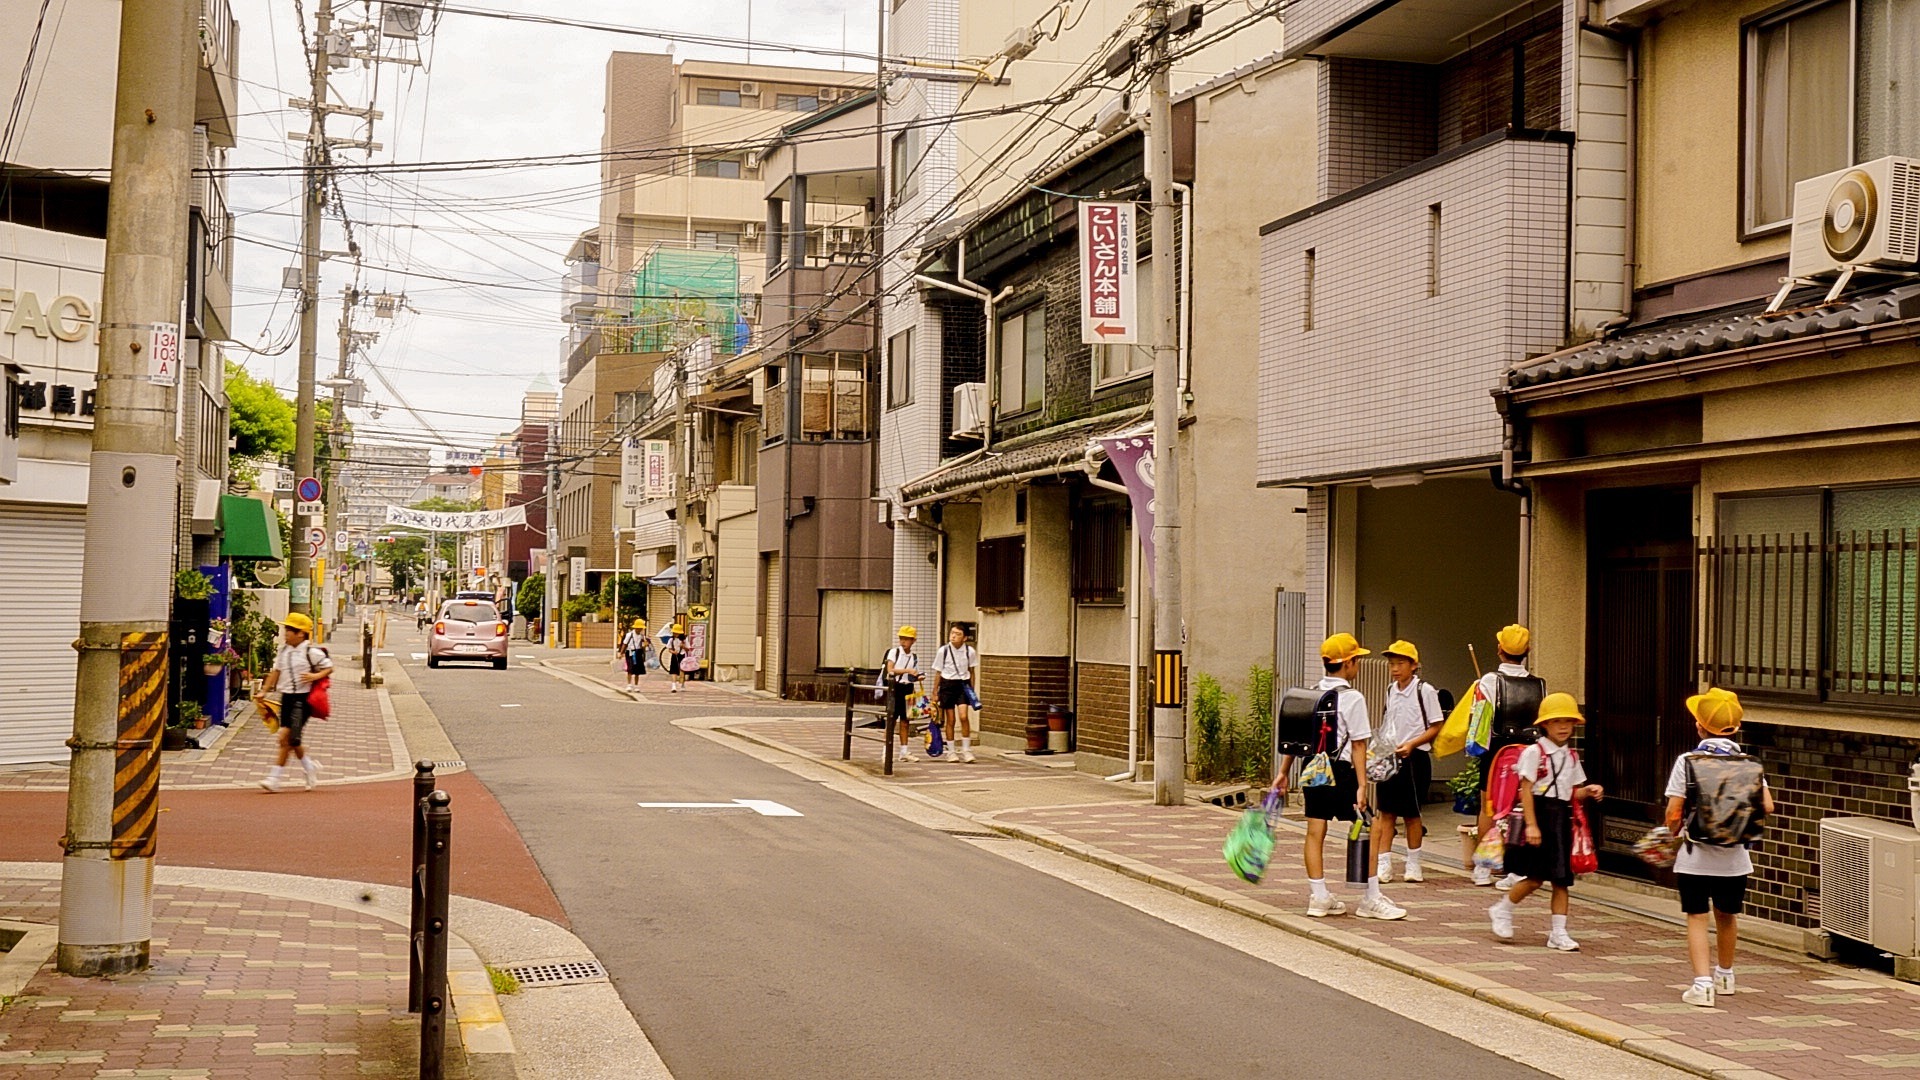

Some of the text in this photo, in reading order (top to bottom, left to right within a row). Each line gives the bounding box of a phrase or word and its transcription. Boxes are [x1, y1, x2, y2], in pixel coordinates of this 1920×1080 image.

[1092, 207, 1118, 315] こいさん本舗
[154, 333, 176, 348] 13A
[153, 346, 176, 361] 103
[160, 361, 168, 375] A
